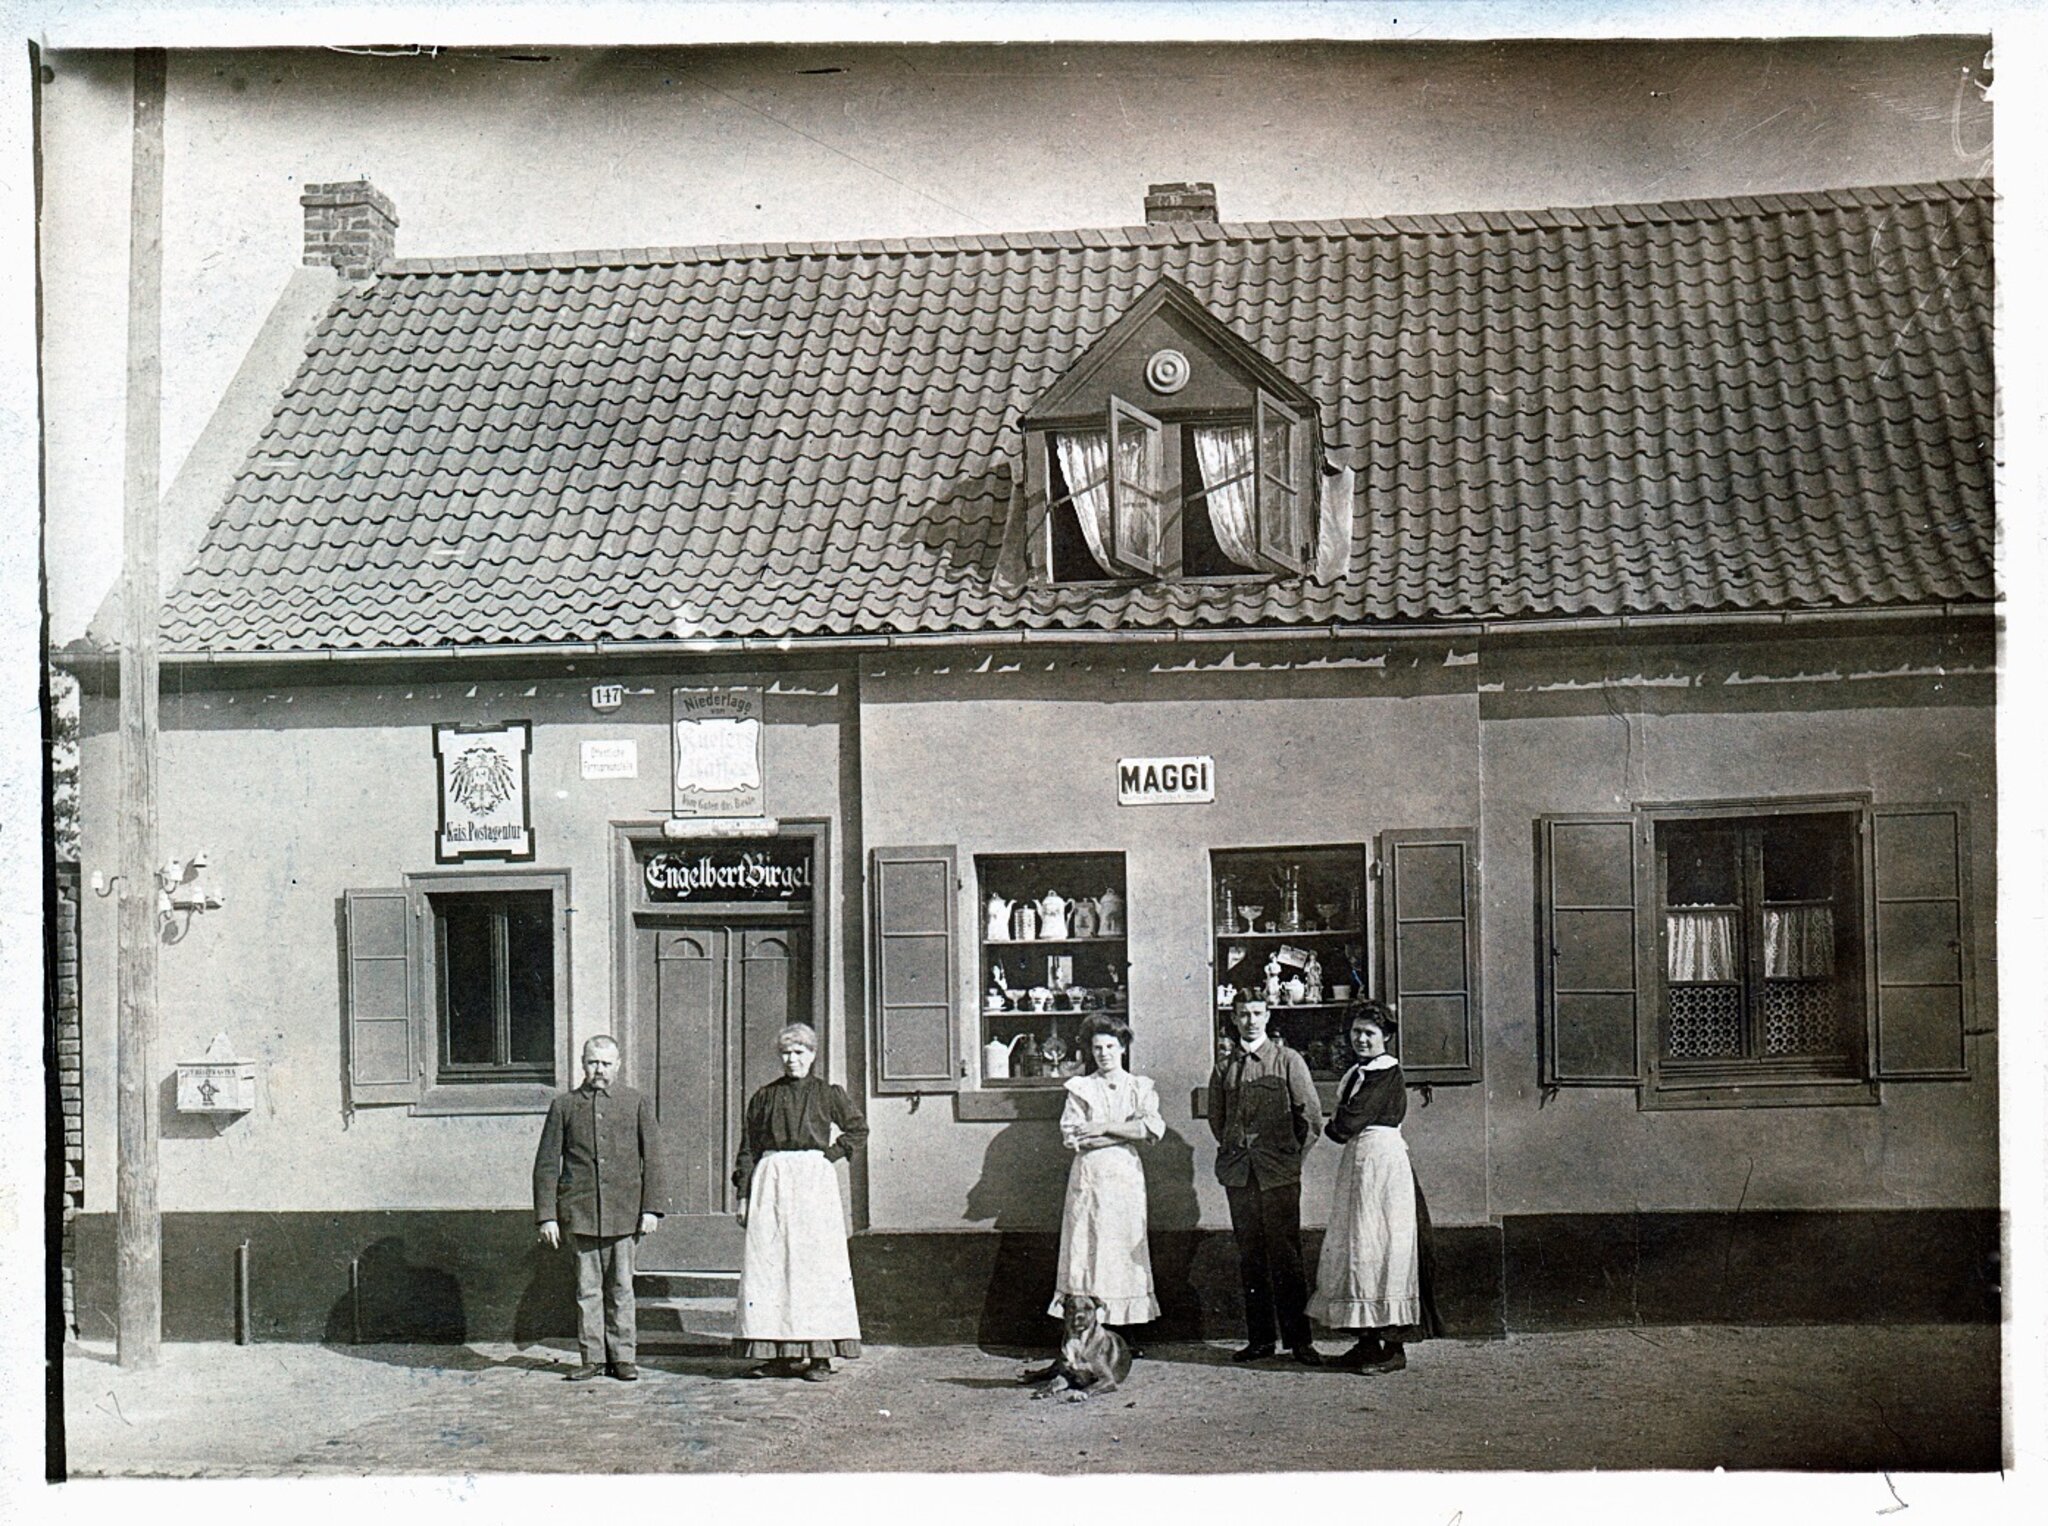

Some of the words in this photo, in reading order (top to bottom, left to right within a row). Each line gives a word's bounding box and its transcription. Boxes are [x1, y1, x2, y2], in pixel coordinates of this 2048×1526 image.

[596, 688, 619, 703] 147
[683, 692, 753, 712] Niederlage
[1120, 762, 1208, 794] MAGGI
[468, 821, 522, 843] Postagentur
[646, 853, 746, 897] Engelbert
[742, 851, 811, 897] Birgel
